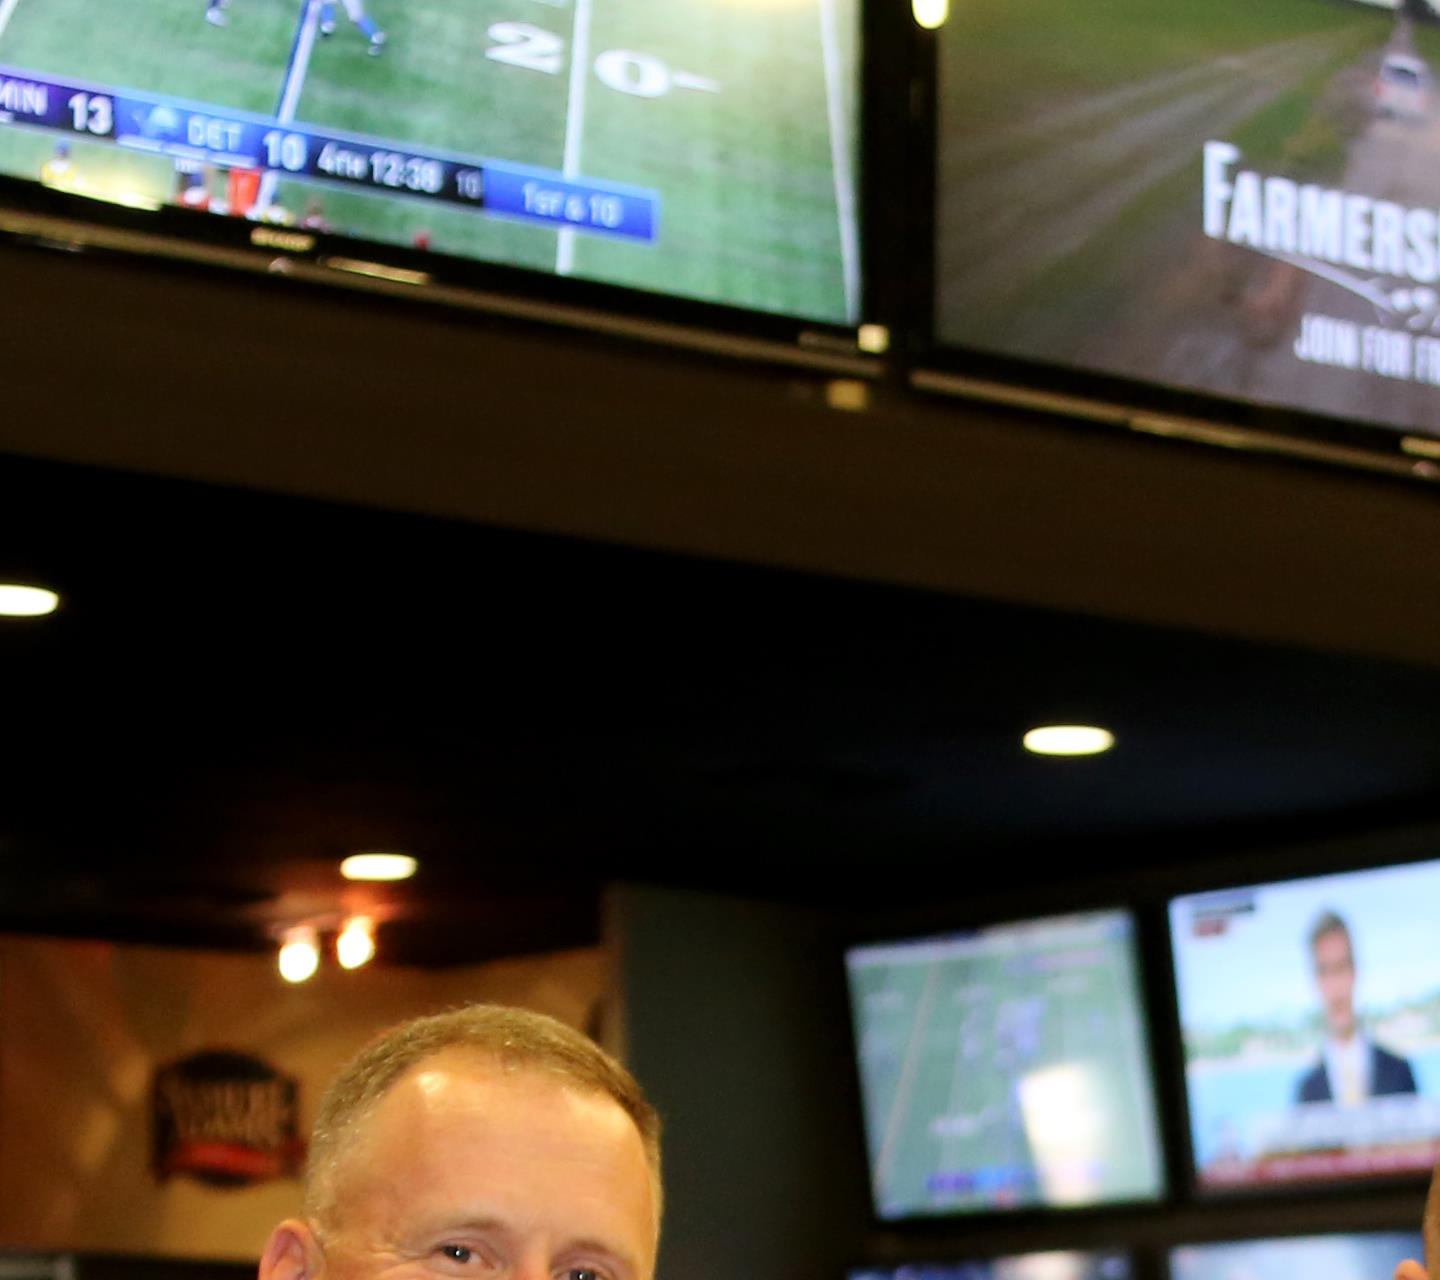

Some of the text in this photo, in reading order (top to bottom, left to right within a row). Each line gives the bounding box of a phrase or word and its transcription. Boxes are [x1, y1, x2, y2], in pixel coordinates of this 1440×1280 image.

[67, 92, 113, 135] 13
[187, 115, 242, 151] DET
[263, 131, 308, 172] 10
[1293, 312, 1361, 370] JOIN
[1361, 325, 1413, 381] FOR
